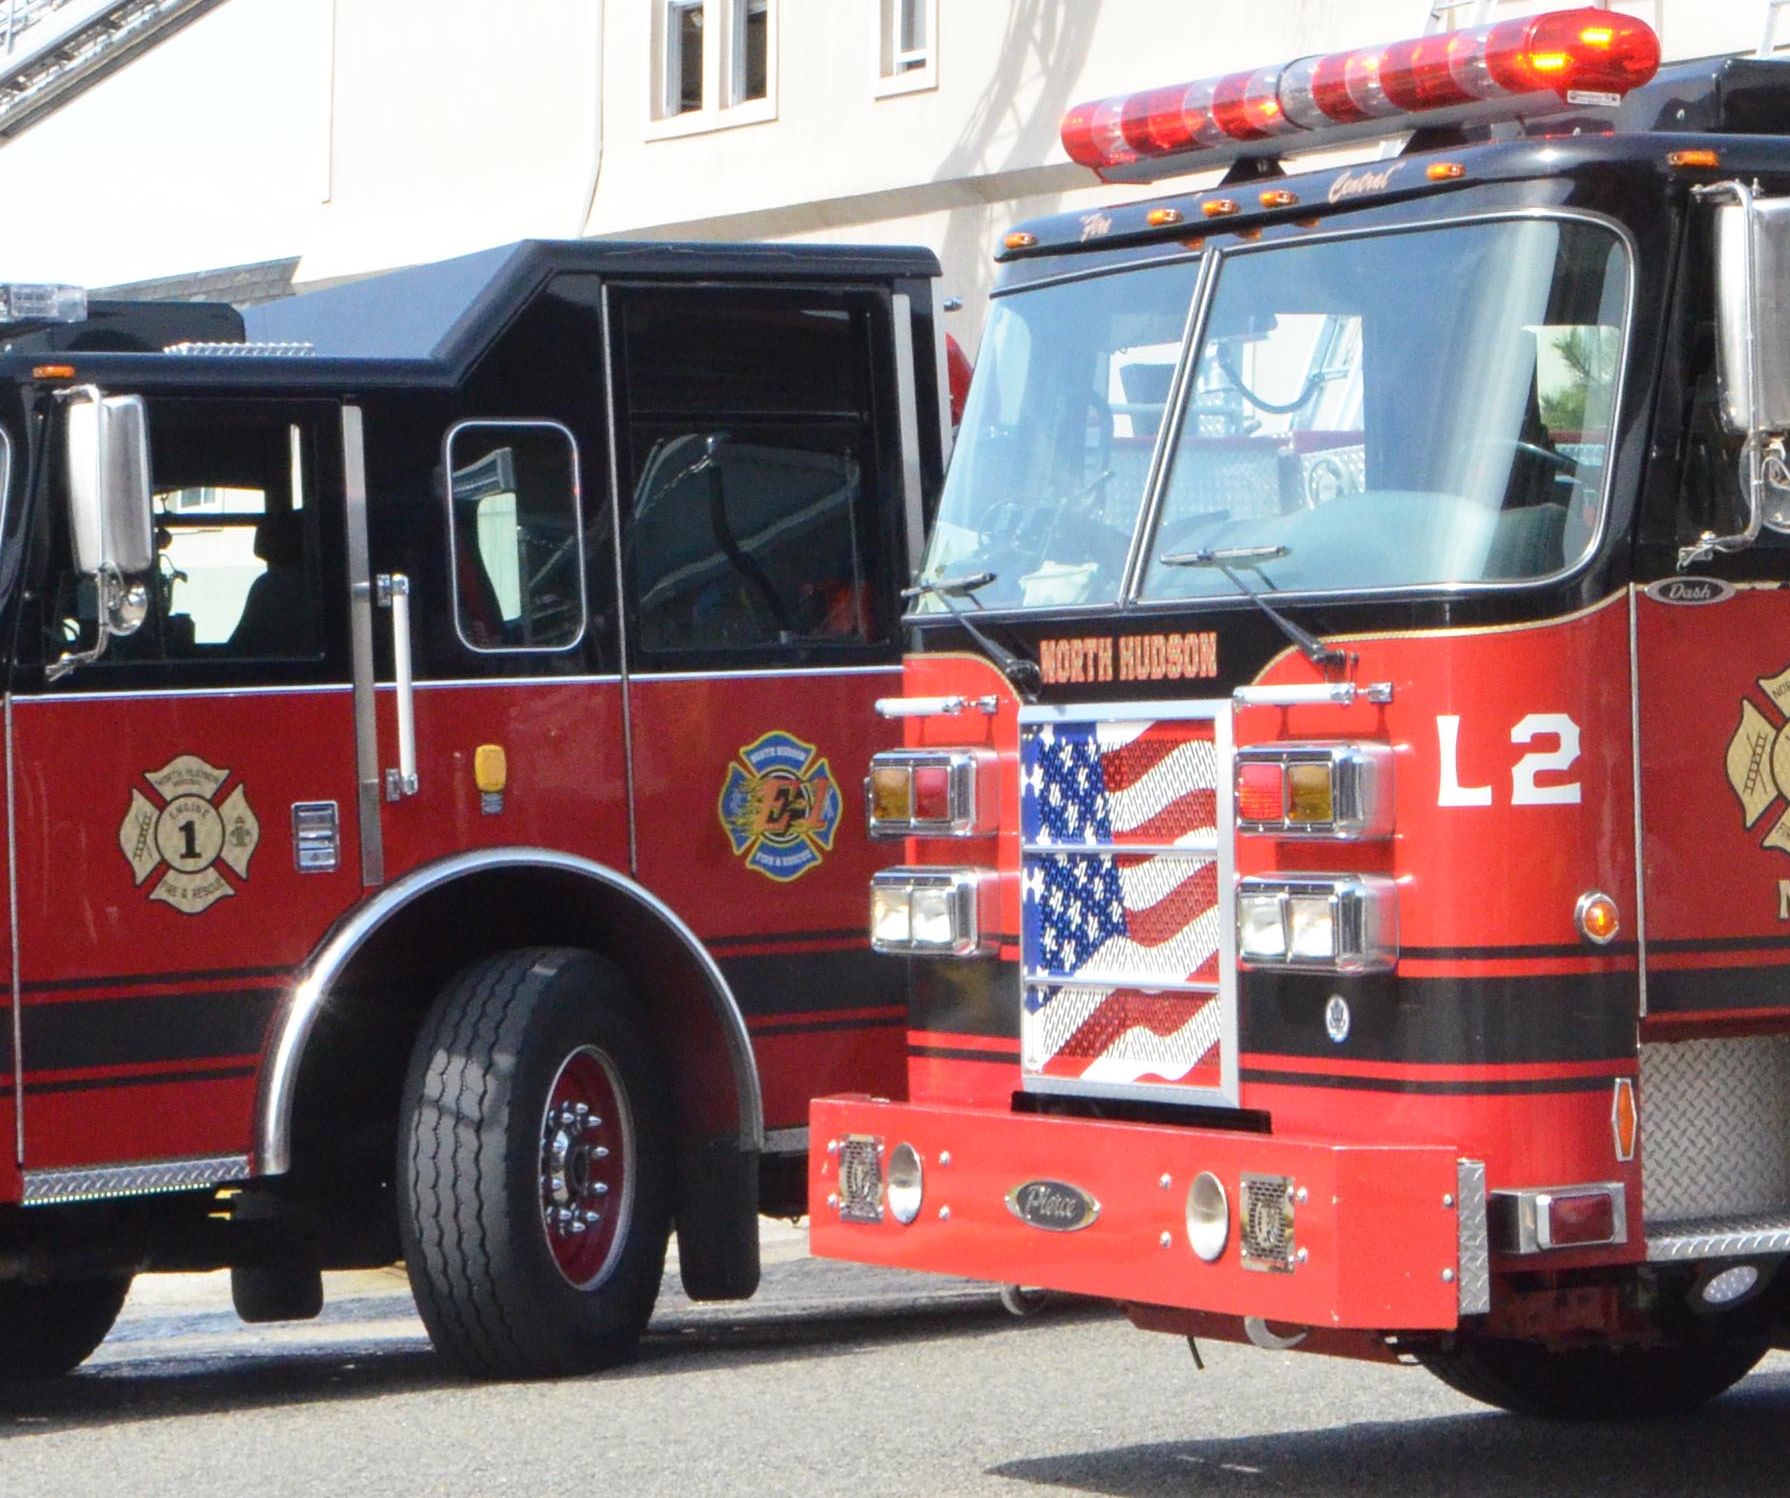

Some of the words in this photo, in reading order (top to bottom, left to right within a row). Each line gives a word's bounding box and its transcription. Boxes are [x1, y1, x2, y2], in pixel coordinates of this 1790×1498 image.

[1669, 582, 1711, 599] Dash
[1040, 637, 1113, 683] NORTH
[1119, 631, 1217, 681] HUDSON
[1436, 715, 1492, 806] L
[1510, 713, 1581, 805] 2
[169, 802, 210, 820] ENGINE
[178, 820, 202, 859] 1
